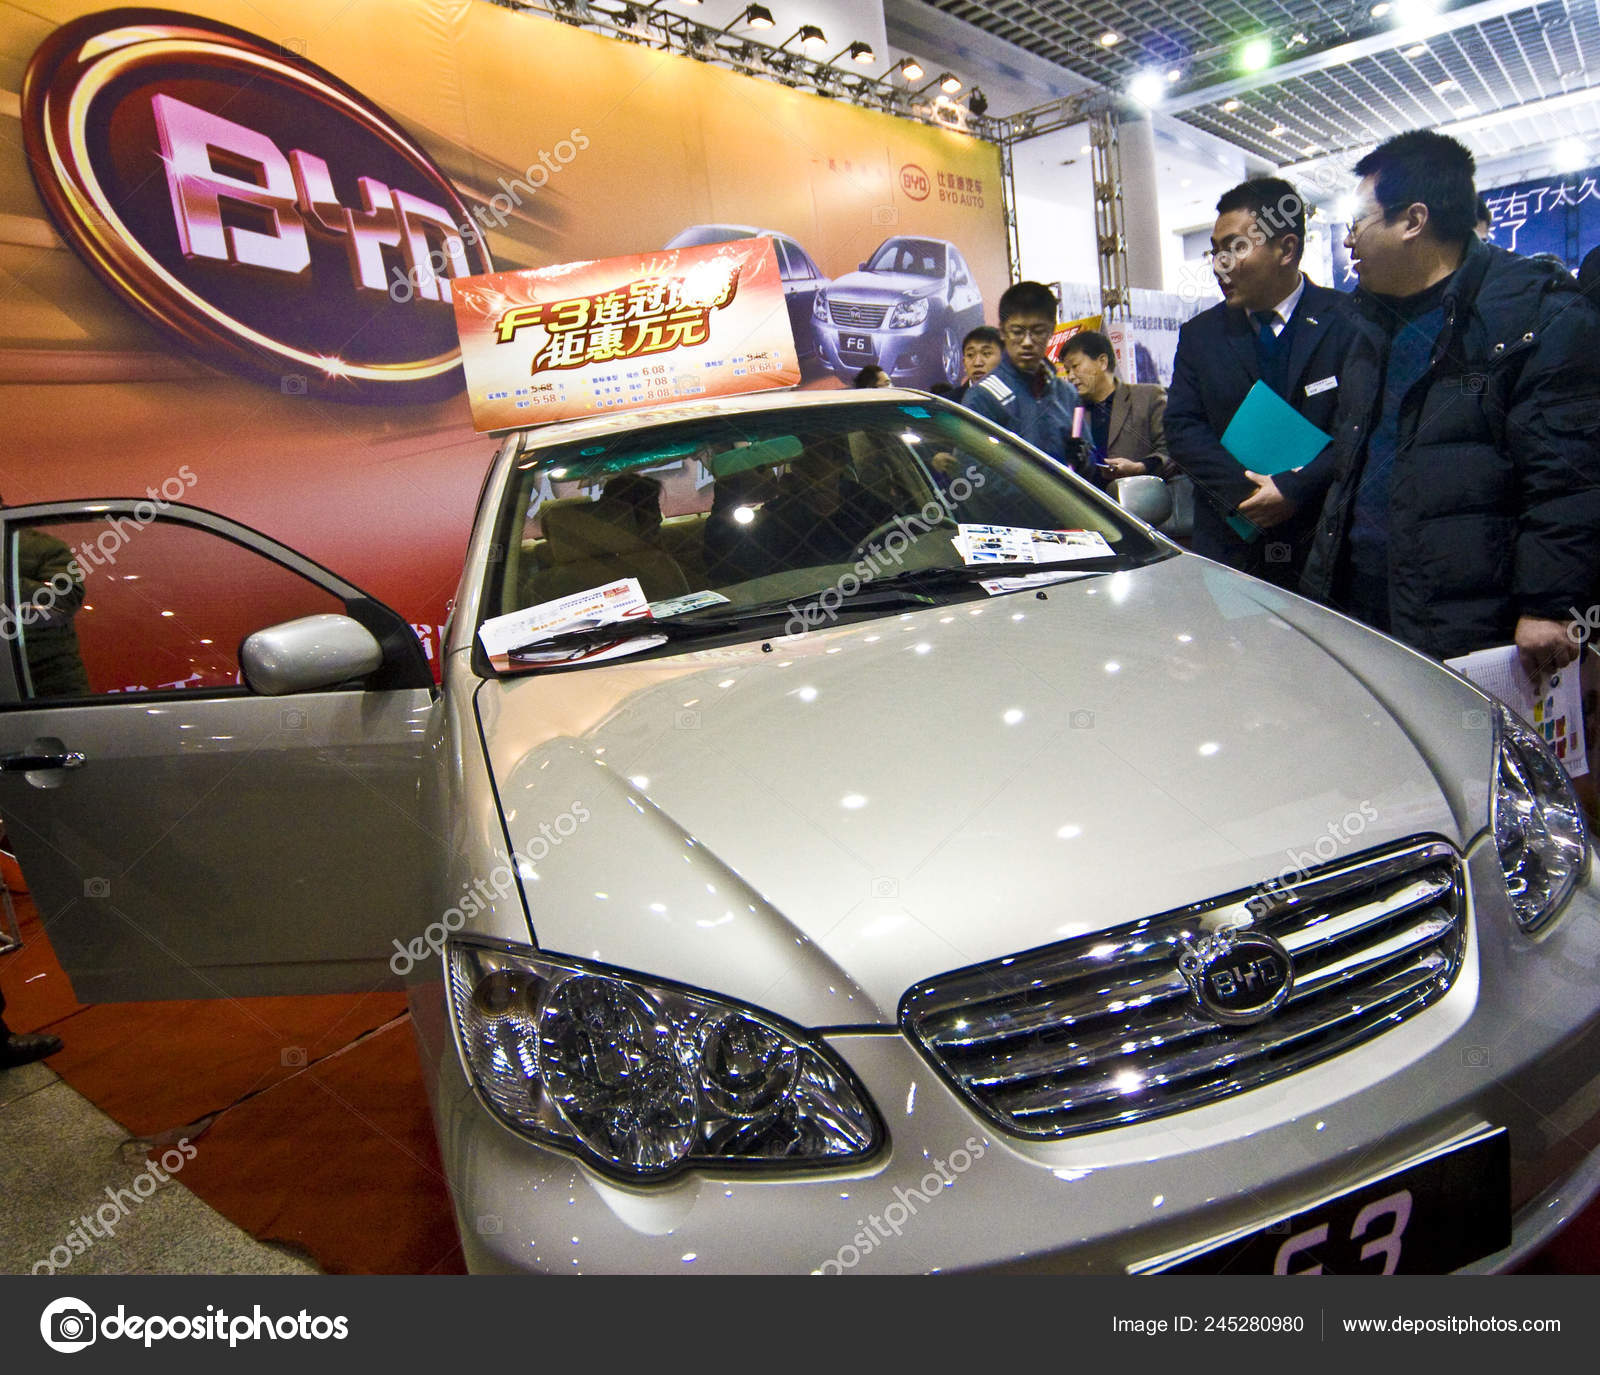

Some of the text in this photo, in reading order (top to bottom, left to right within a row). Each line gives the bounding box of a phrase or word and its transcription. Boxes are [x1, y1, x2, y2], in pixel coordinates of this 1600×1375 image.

[903, 173, 927, 193] BYD
[152, 92, 472, 304] BYD
[939, 189, 984, 208] BYD AUTO
[847, 337, 865, 350] F6
[1210, 955, 1284, 999] BYD
